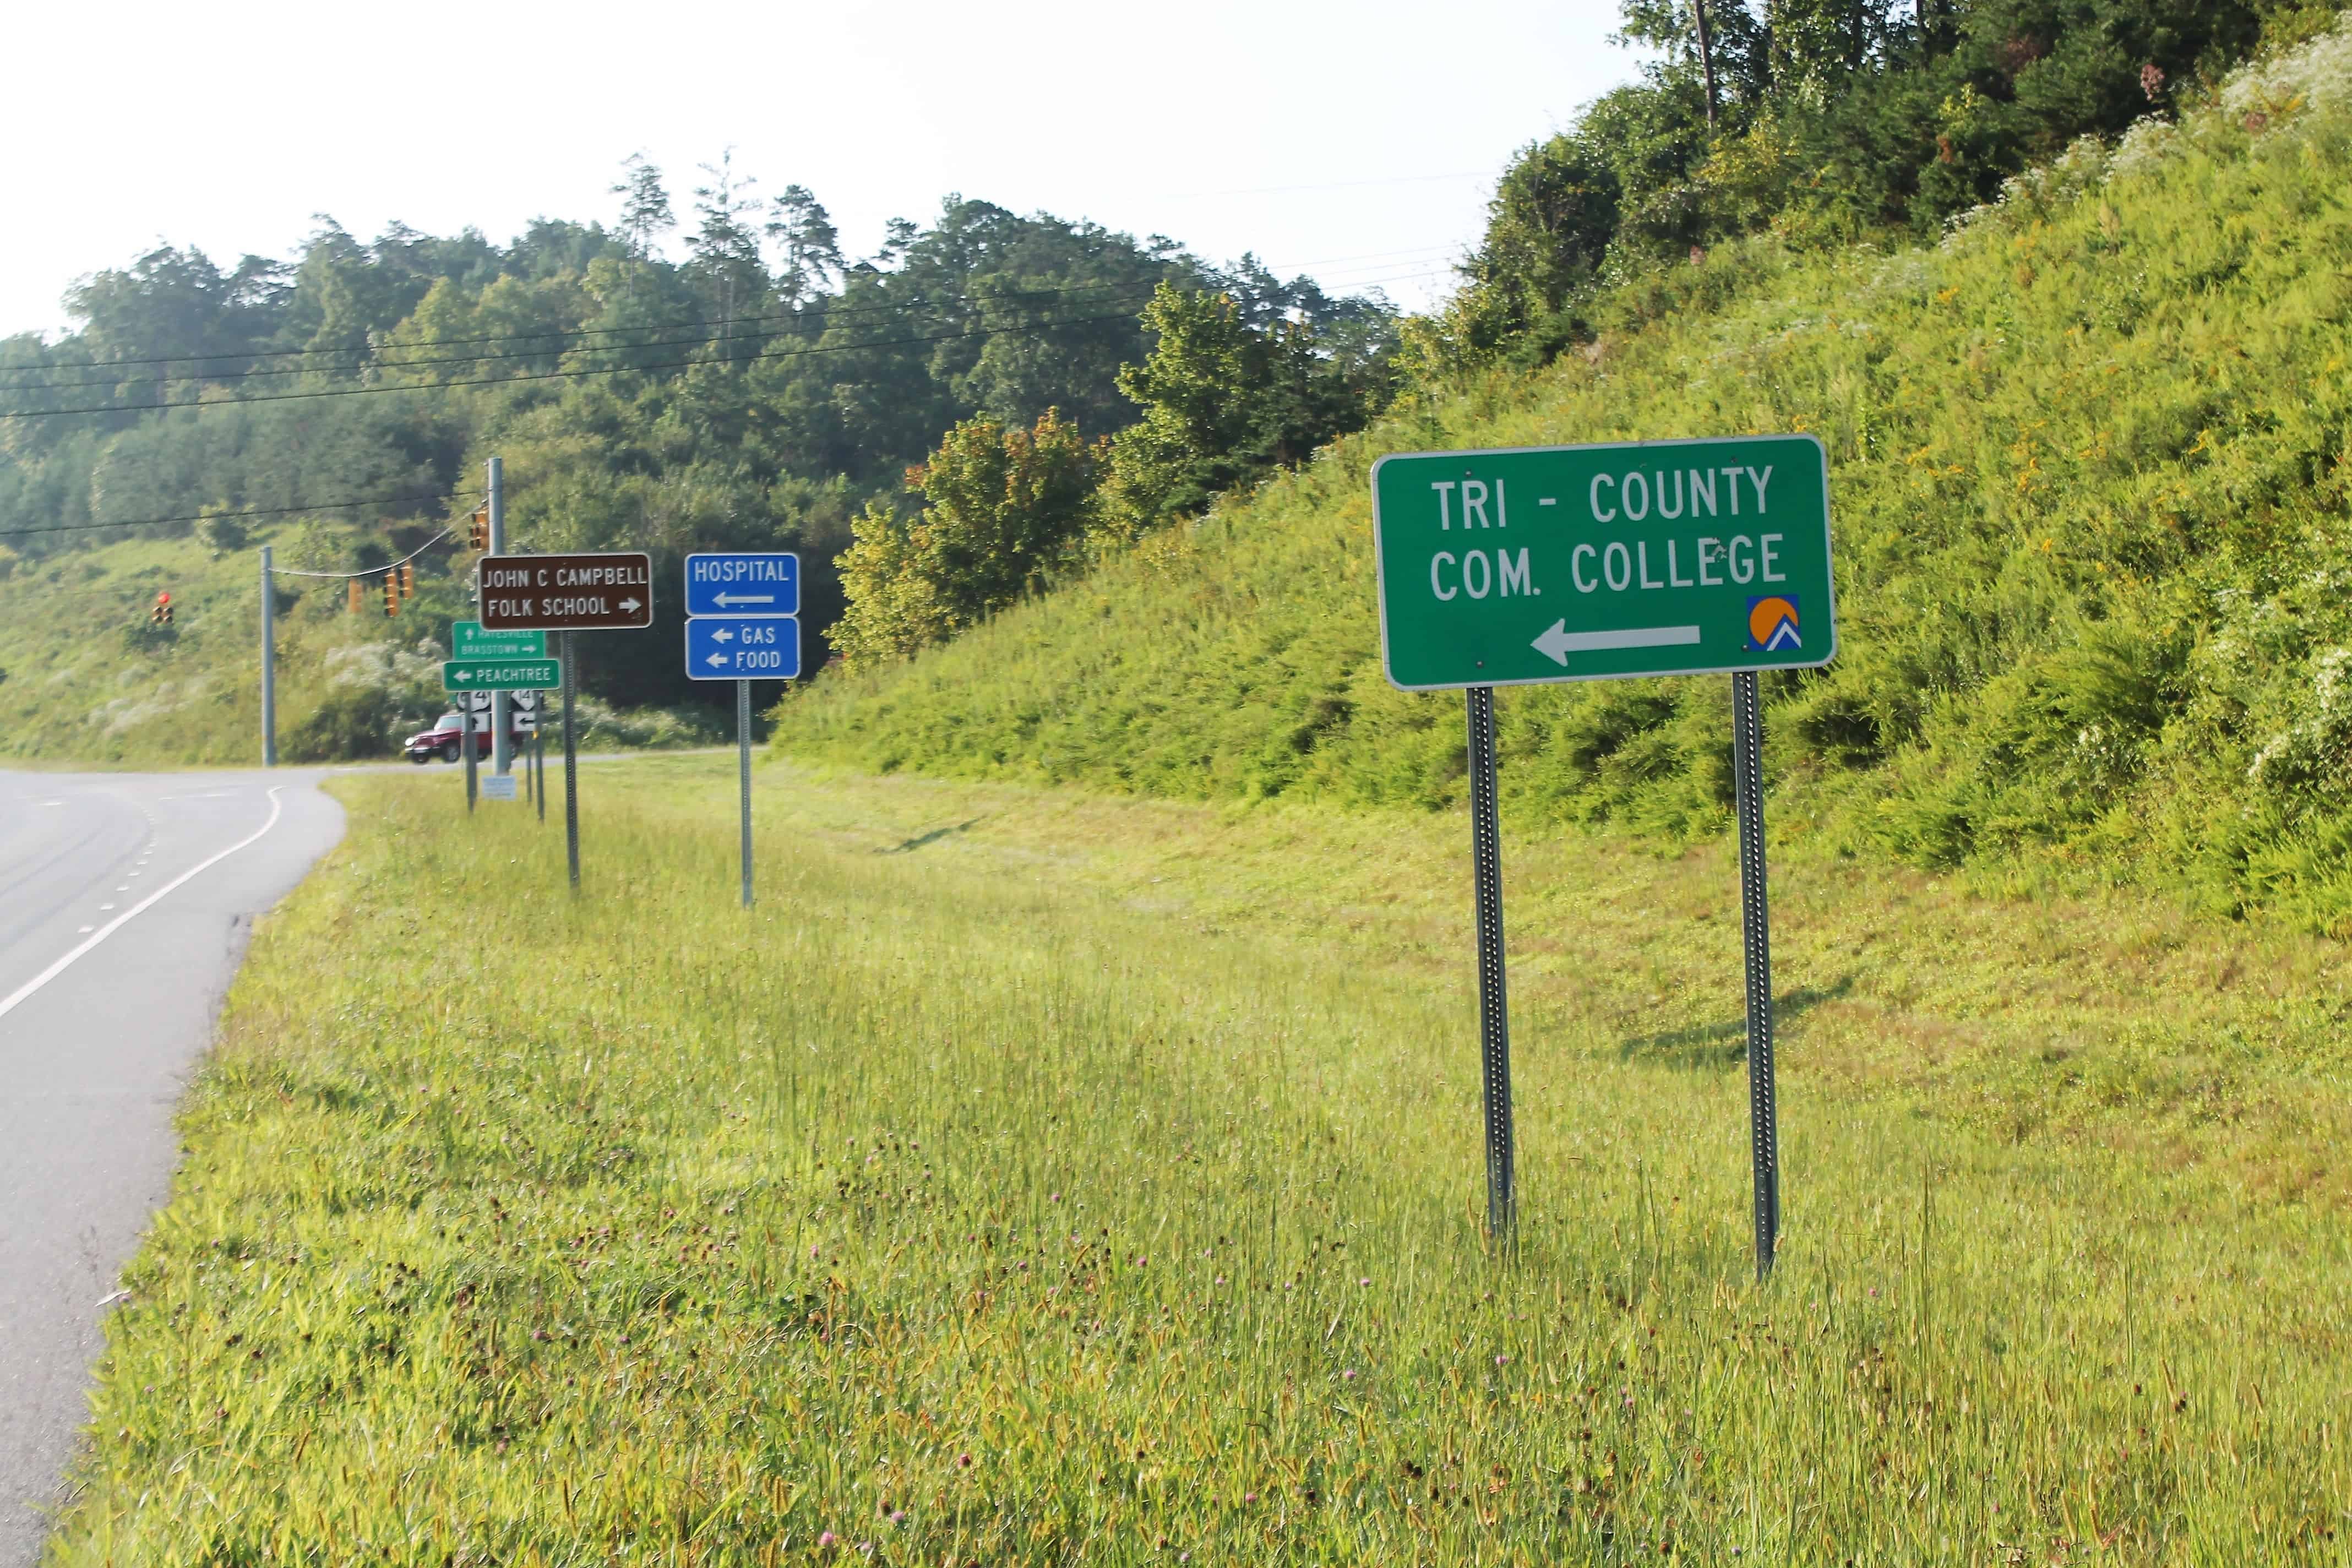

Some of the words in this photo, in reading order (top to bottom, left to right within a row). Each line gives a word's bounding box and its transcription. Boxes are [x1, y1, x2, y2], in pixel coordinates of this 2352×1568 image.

[1431, 478, 1506, 530] TRI
[1589, 465, 1774, 522] COUNTY
[482, 570, 529, 587] JOHN
[537, 569, 548, 586] C
[557, 567, 648, 586] CAMPBELL
[695, 560, 789, 581] HOSPITAL
[1430, 548, 1542, 601] COM.
[1572, 533, 1786, 594] COLLEGE
[488, 598, 532, 617] FOLK
[542, 597, 611, 616] SCHOOL
[741, 627, 776, 644] GAS
[461, 645, 518, 655] BRASSTOWN
[736, 652, 781, 668] FOOD
[476, 668, 551, 682] PEACHTREE
